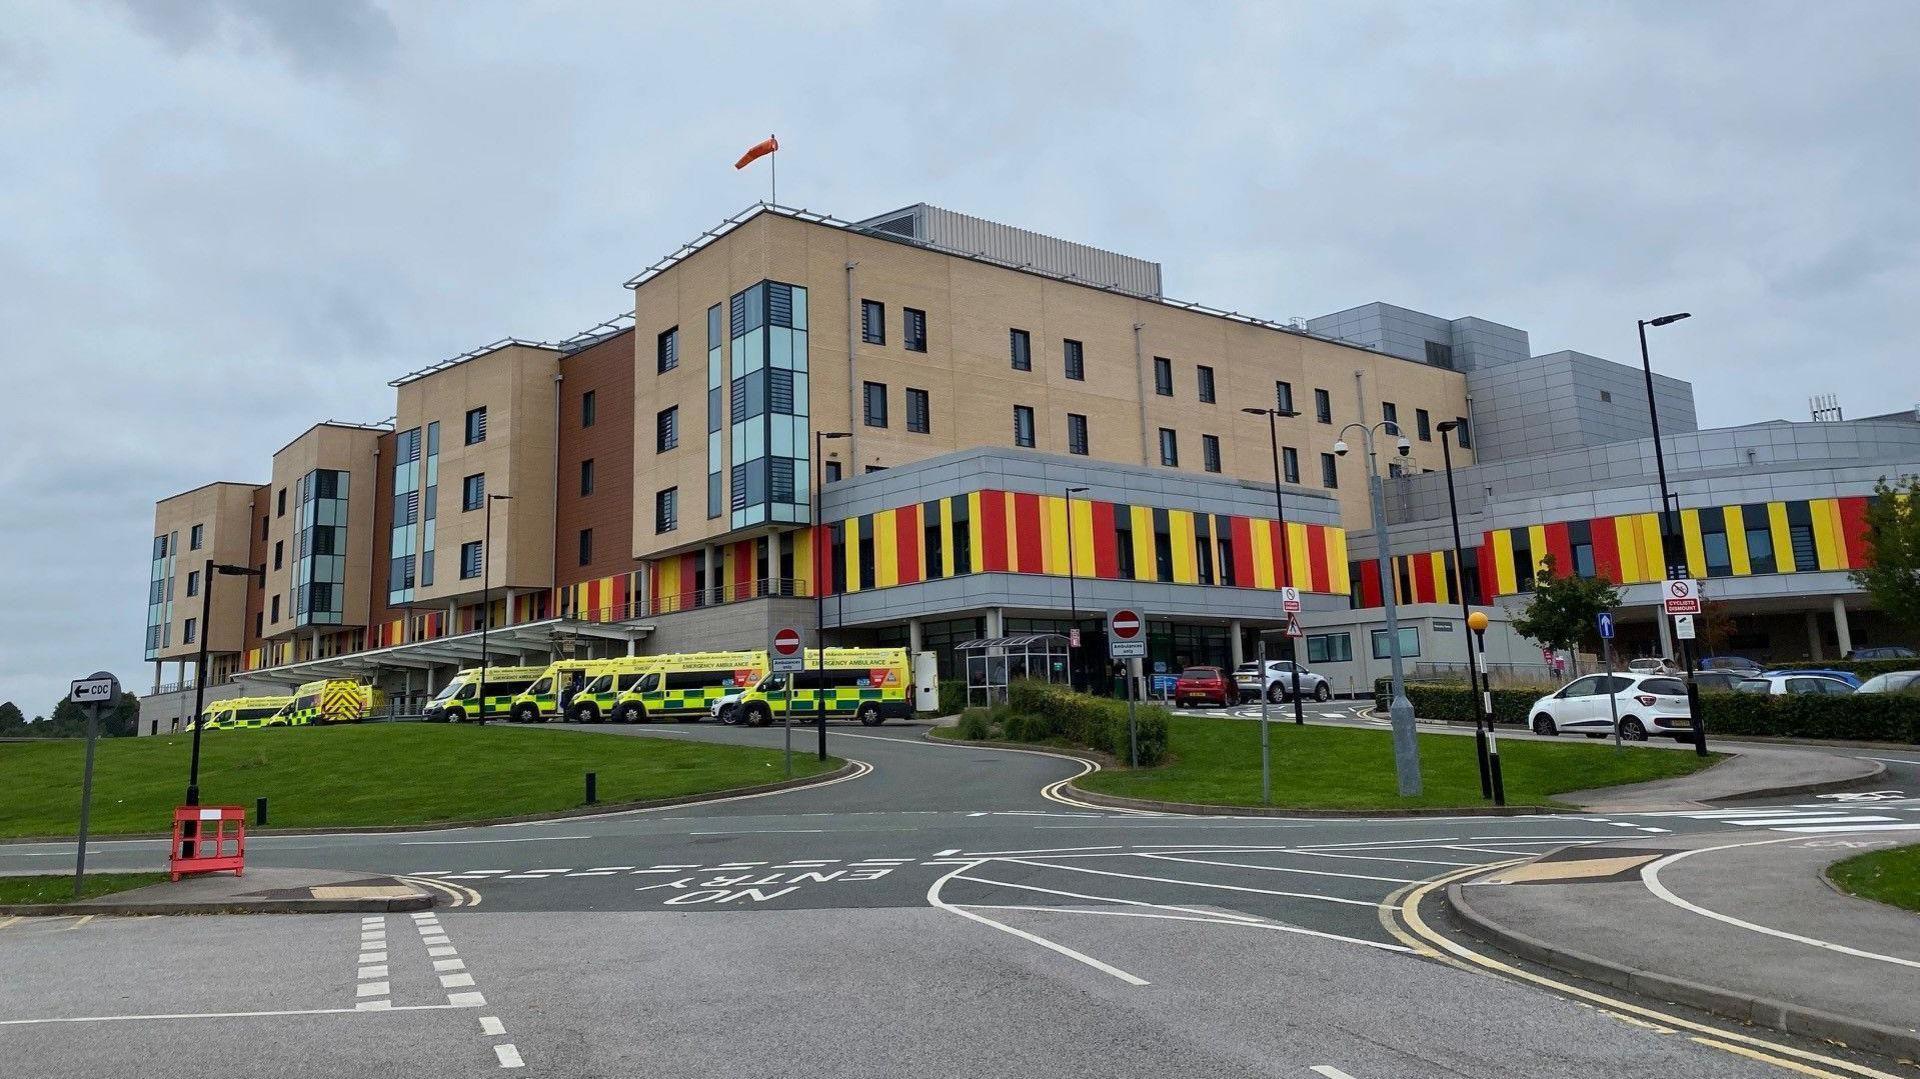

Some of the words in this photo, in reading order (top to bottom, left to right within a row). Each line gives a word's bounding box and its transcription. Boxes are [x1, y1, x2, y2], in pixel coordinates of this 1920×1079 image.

[91, 685, 109, 695] CDC
[635, 868, 893, 891] ENTRY
[663, 886, 801, 905] NO
